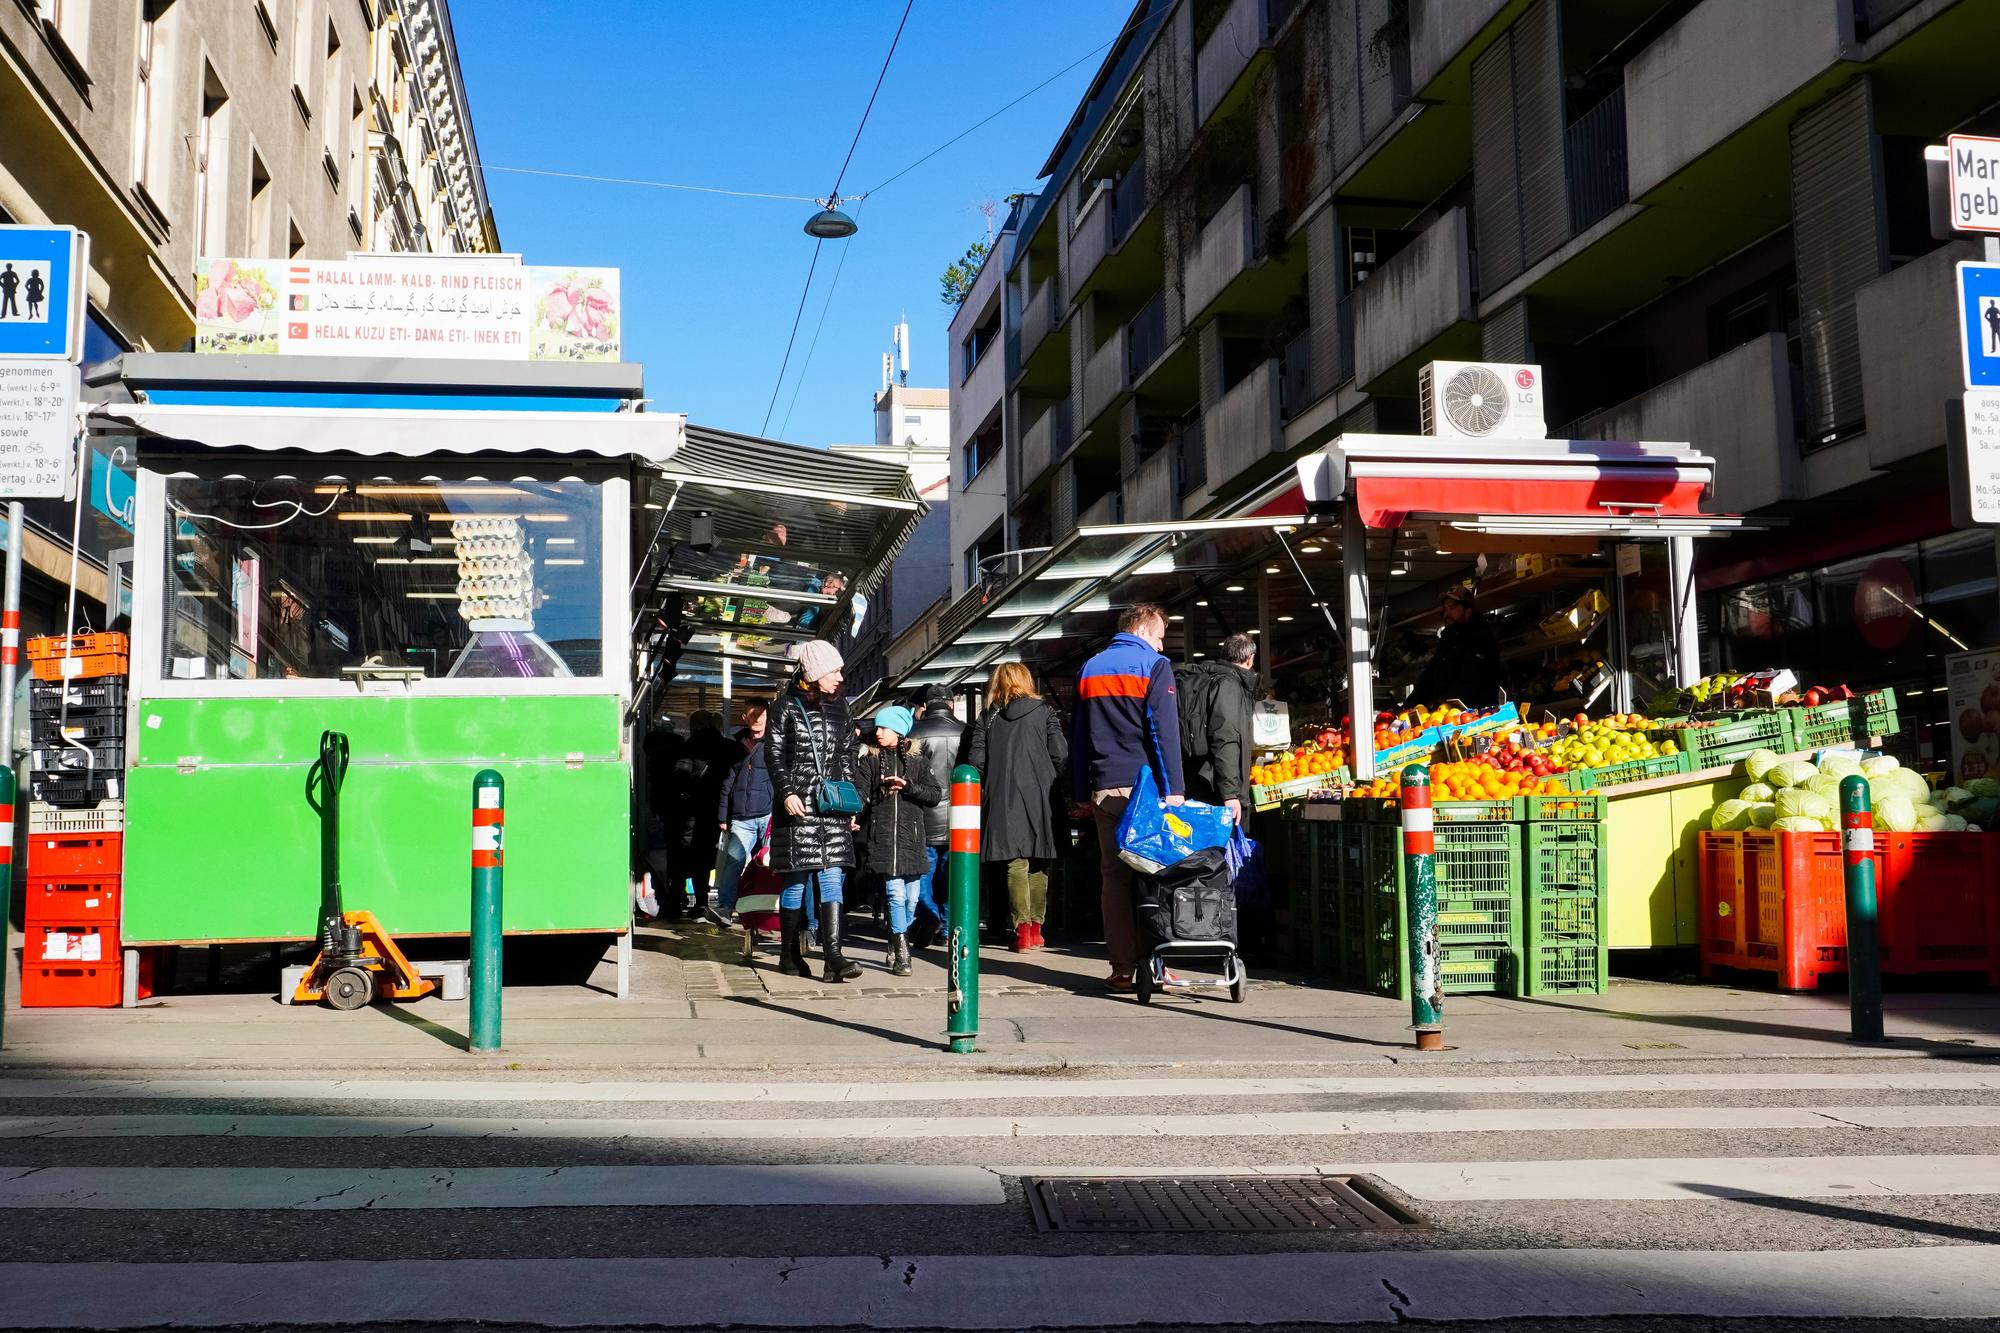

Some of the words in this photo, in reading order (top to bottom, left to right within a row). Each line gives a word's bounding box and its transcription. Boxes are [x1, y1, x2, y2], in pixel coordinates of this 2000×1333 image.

[1956, 148, 1999, 179] Mar
[1960, 187, 1999, 221] geb
[316, 271, 354, 285] HALAL
[359, 272, 396, 286] LAMM-
[402, 273, 436, 288] KALB-
[441, 275, 469, 289] RIND
[474, 276, 522, 290] FLEISCH
[315, 325, 351, 340] HELAL
[354, 326, 385, 341] KUZU
[415, 328, 444, 342] DANA
[474, 330, 499, 344] INEK
[504, 331, 521, 344] ETI
[1518, 393, 1534, 403] LG
[1, 427, 29, 437] sowie
